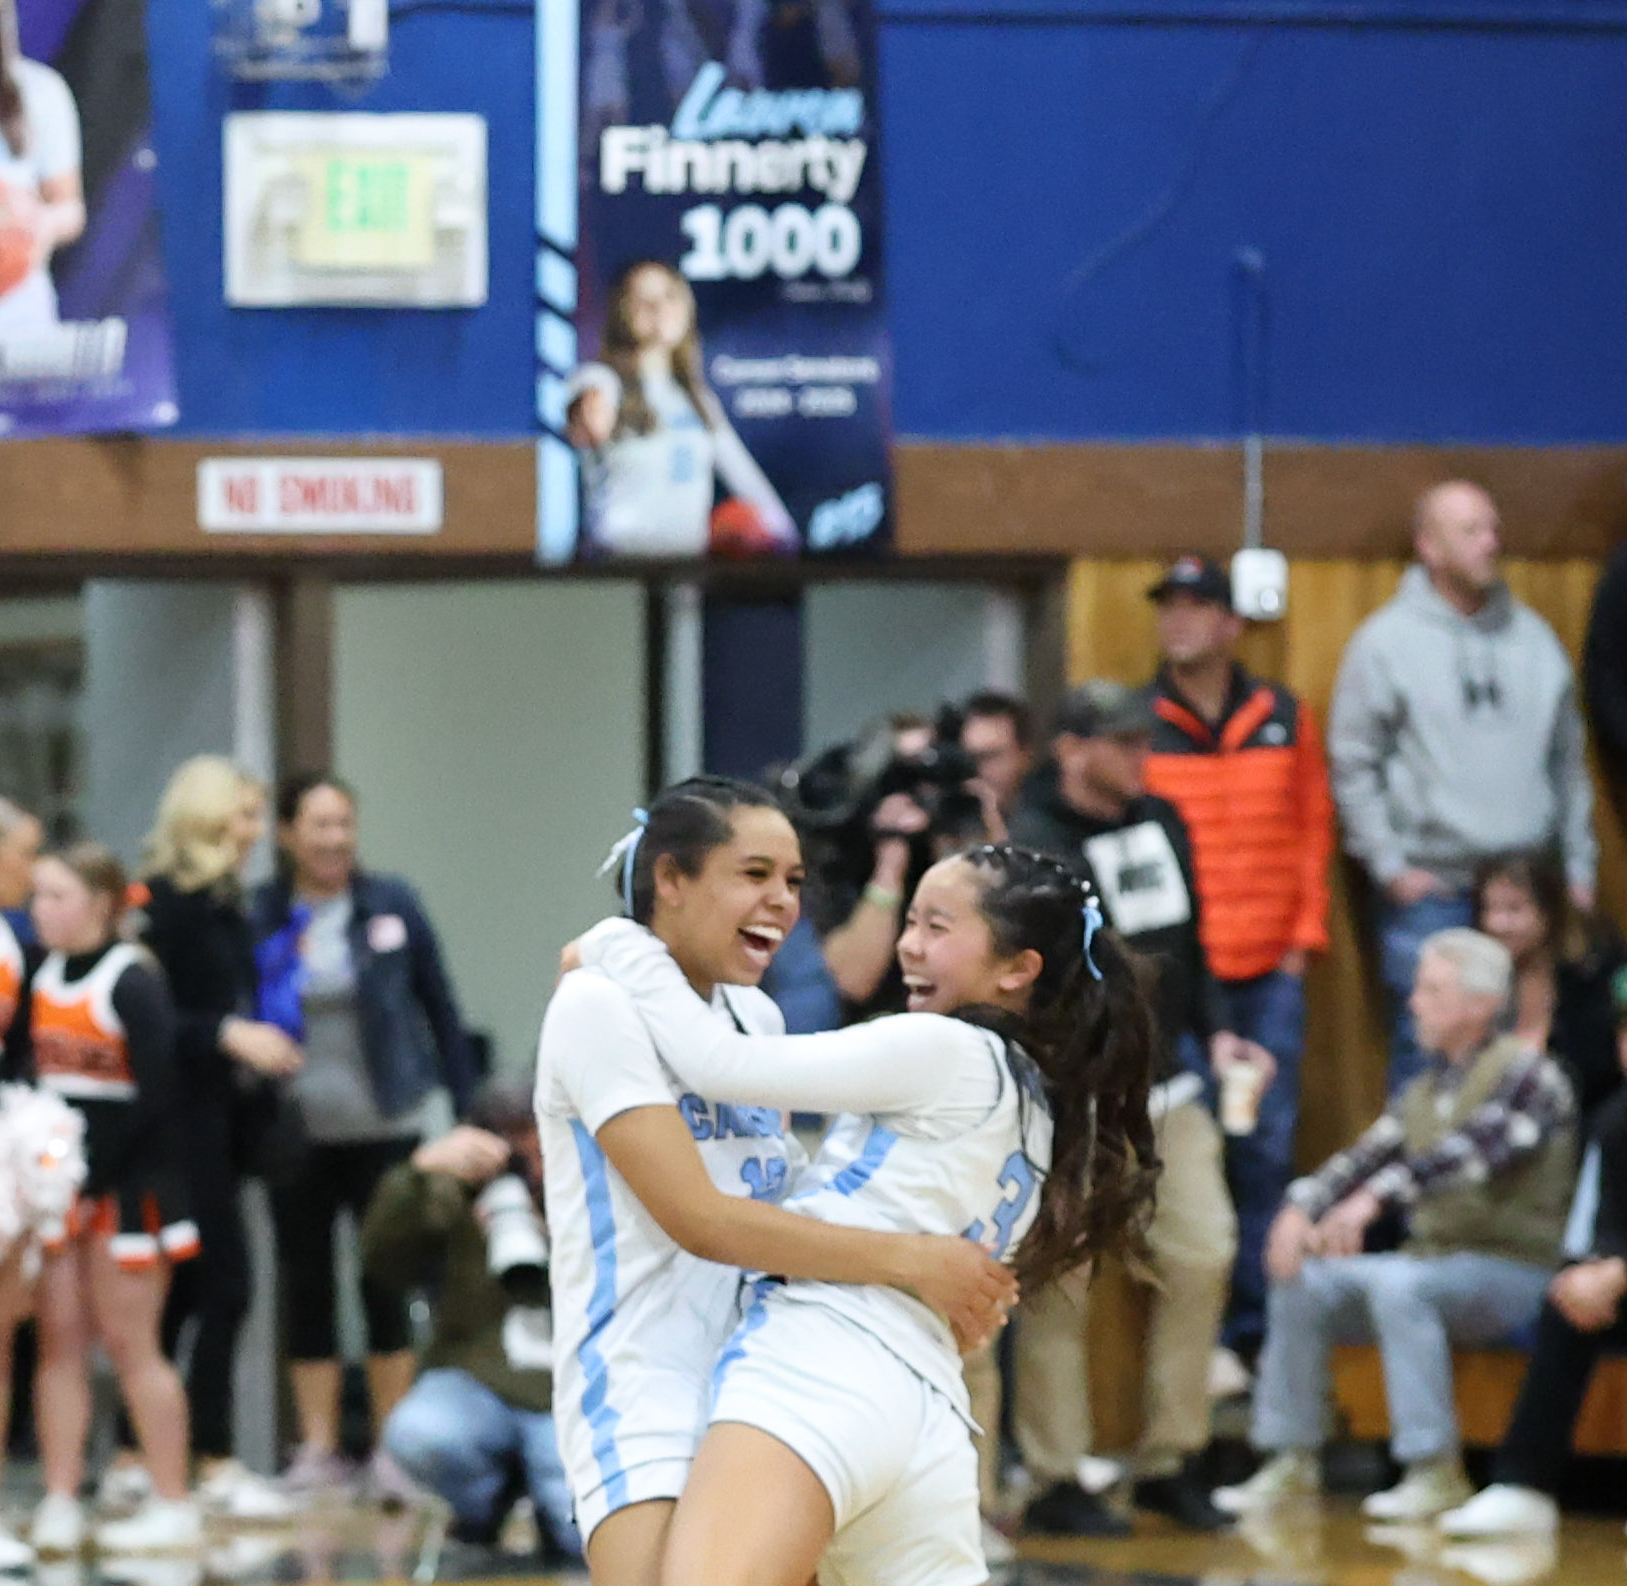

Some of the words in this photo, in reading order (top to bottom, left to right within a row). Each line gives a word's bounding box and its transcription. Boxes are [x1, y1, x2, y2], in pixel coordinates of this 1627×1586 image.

[600, 125, 866, 205] Finnerty
[679, 202, 862, 281] 1000
[224, 474, 259, 514] NO
[277, 474, 416, 514] SMOKING
